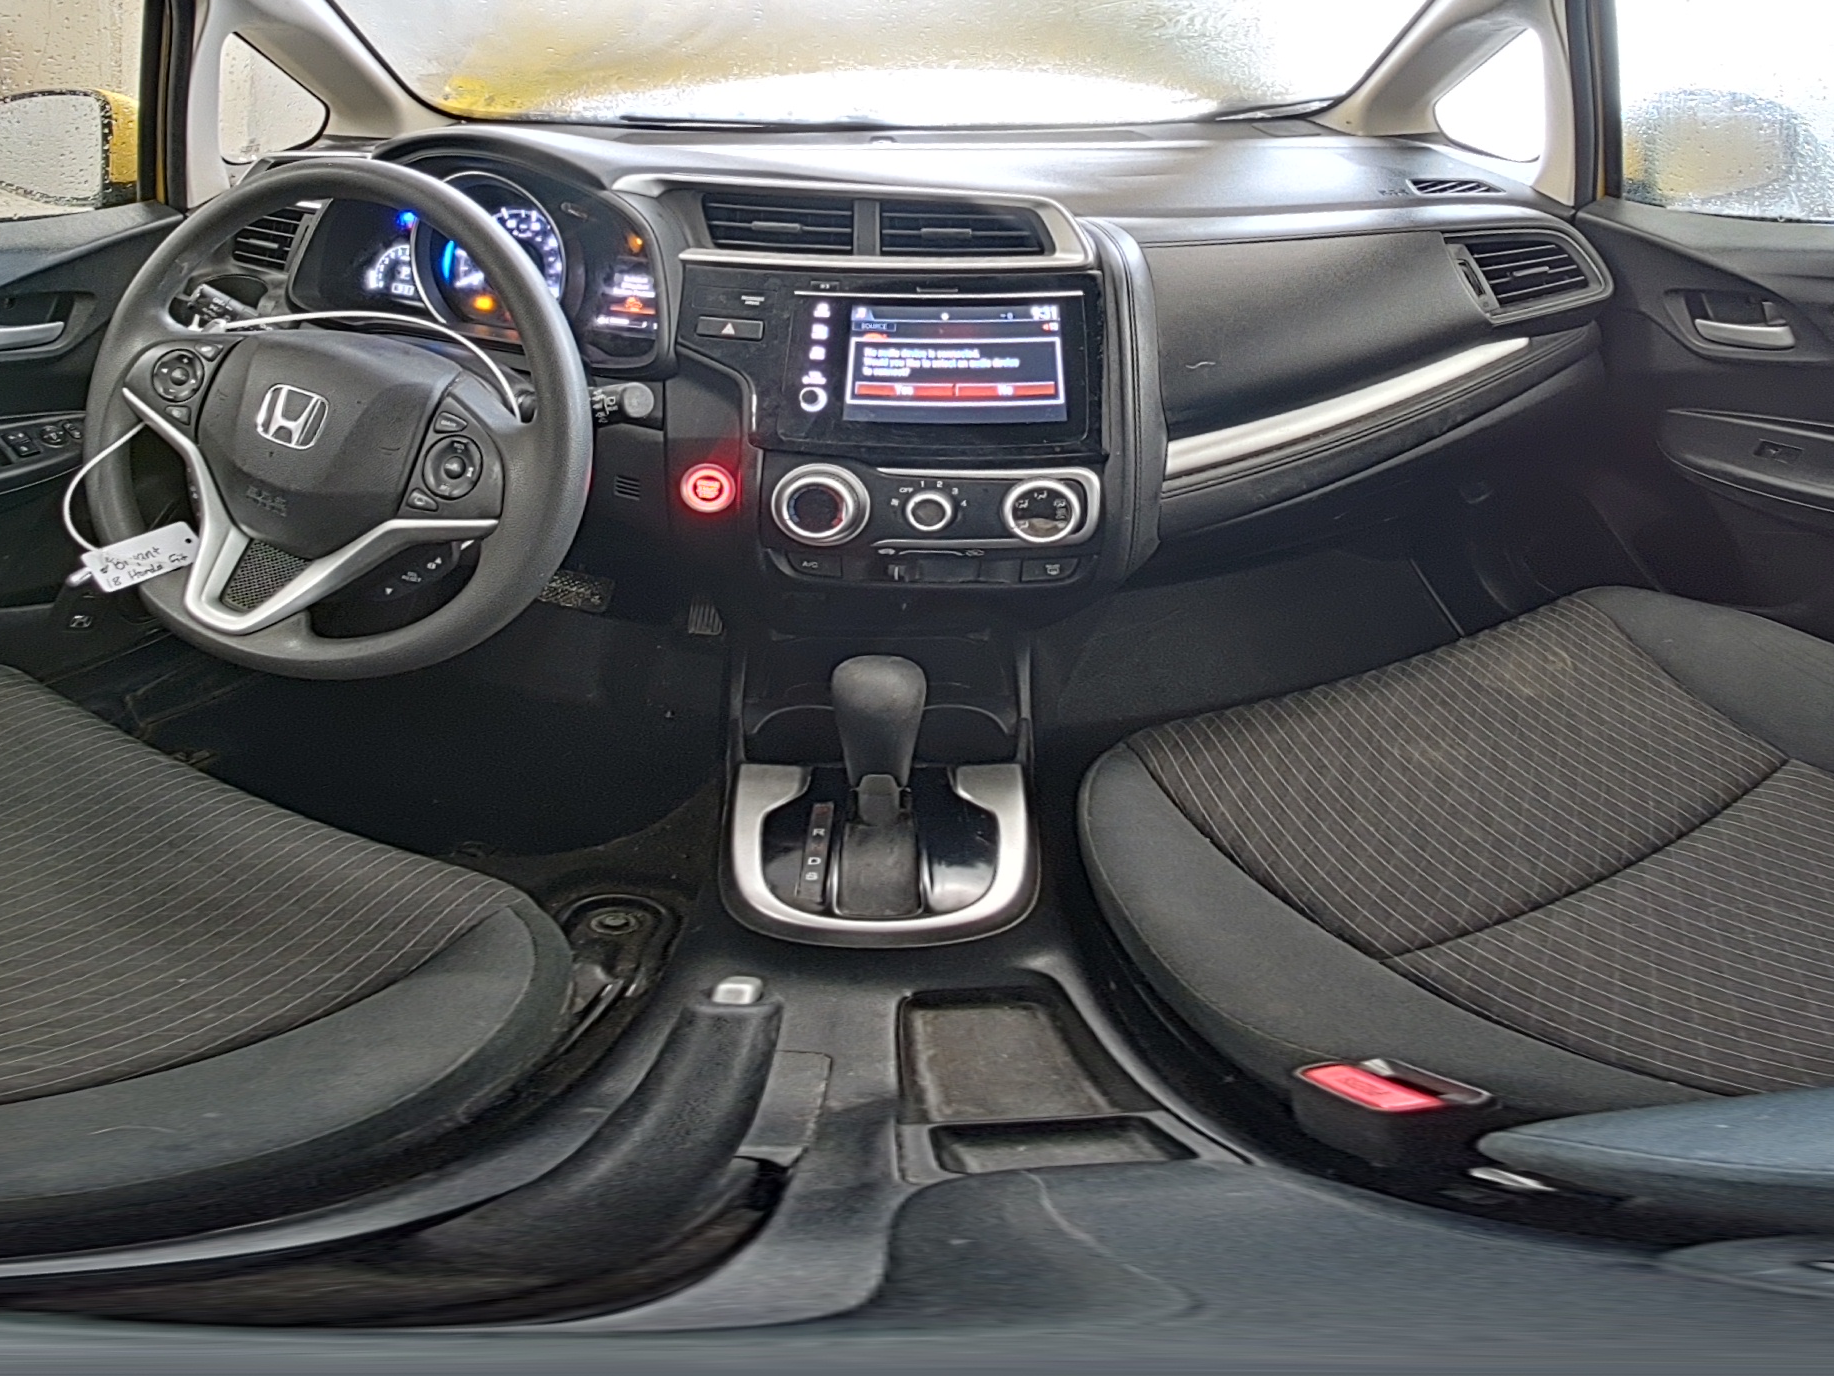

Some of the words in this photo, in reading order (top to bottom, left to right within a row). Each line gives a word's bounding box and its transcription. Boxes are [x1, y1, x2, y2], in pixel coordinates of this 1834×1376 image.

[894, 384, 914, 395] Yes
[812, 828, 826, 836] R
[807, 856, 822, 865] D
